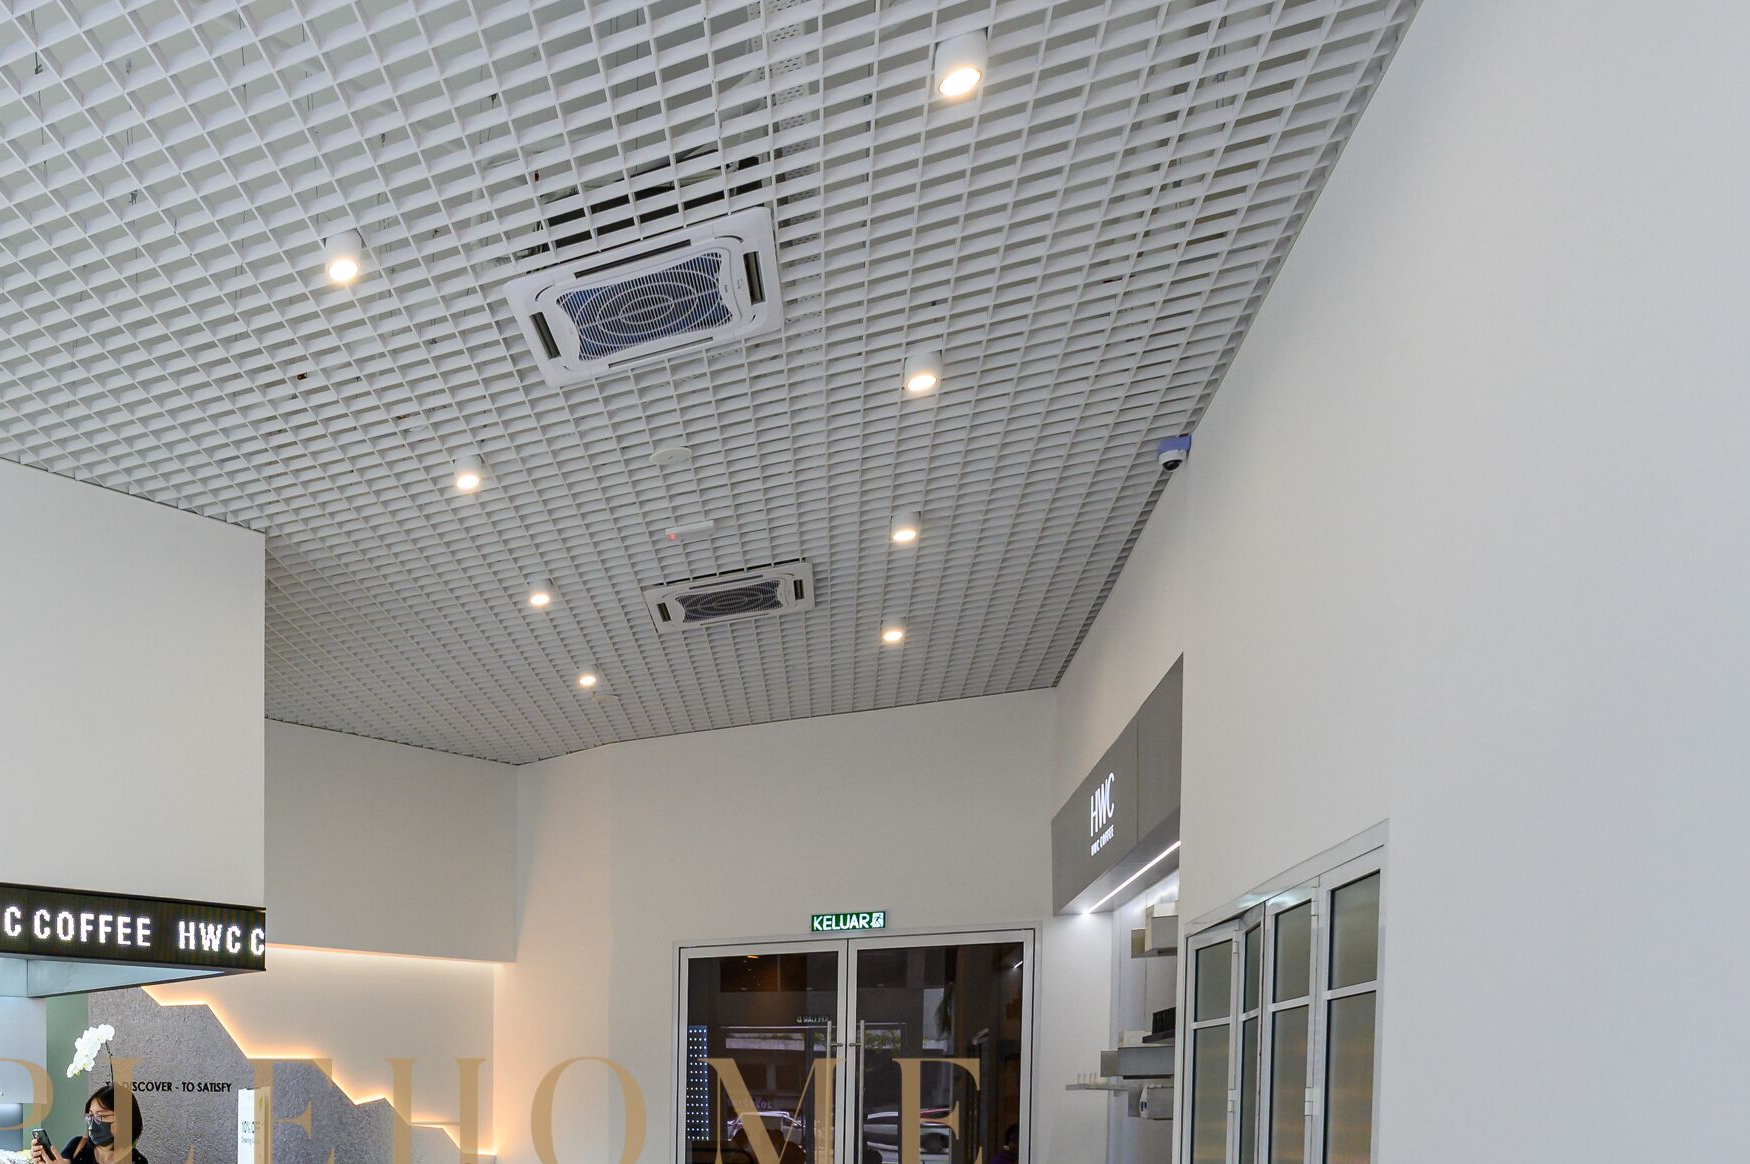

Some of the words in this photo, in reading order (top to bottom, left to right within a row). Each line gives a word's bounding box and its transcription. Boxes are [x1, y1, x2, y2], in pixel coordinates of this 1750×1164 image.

[1090, 772, 1115, 837] HWC
[34, 909, 151, 947] COFFEE
[179, 921, 241, 954] HWC
[813, 913, 869, 931] KELUAR
[181, 1081, 194, 1092] TO
[197, 1081, 232, 1093] SATISFY
